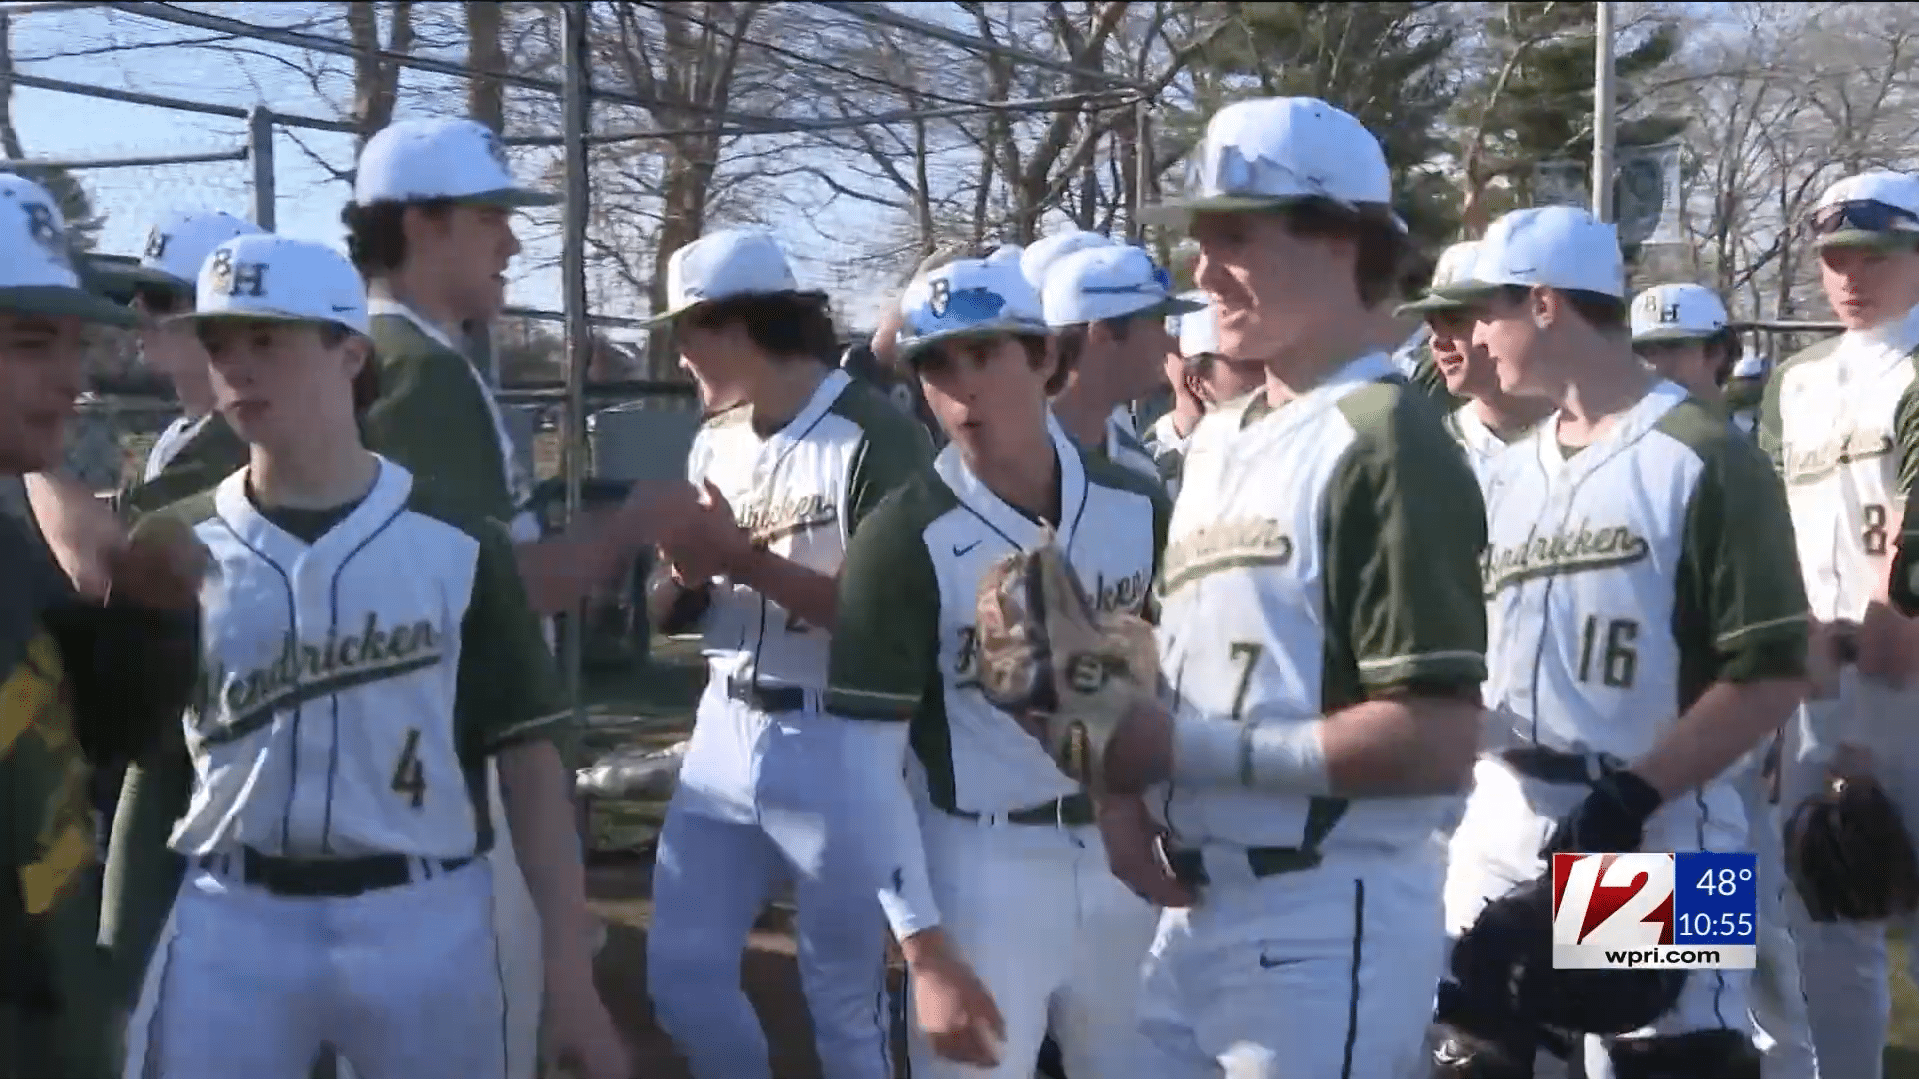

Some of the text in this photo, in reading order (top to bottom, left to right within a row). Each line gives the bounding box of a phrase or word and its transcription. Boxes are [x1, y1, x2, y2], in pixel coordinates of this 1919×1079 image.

[1862, 503, 1888, 556] 8
[1229, 641, 1263, 720] 7
[1579, 614, 1639, 689] 16
[391, 728, 426, 808] 4
